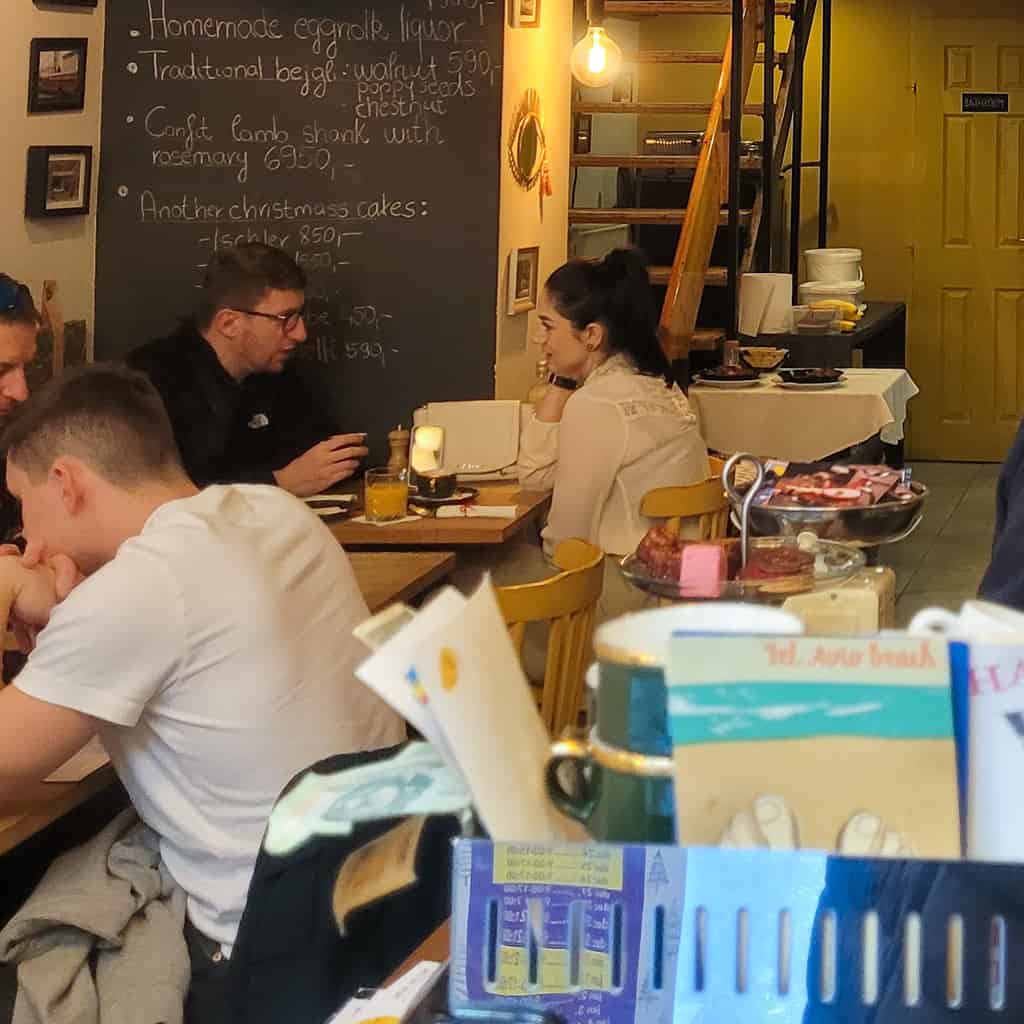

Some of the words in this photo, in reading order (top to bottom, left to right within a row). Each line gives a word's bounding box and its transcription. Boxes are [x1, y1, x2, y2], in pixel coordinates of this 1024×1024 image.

[401, 2, 466, 63] liquor
[137, 49, 264, 81] Traditional
[354, 50, 438, 81] walnut
[355, 93, 448, 119] chestnut
[357, 80, 415, 102] poppy
[231, 113, 289, 142] lamb
[302, 117, 370, 145] shank
[383, 114, 445, 145] with
[152, 150, 248, 184] rosemary
[140, 189, 225, 222] Another
